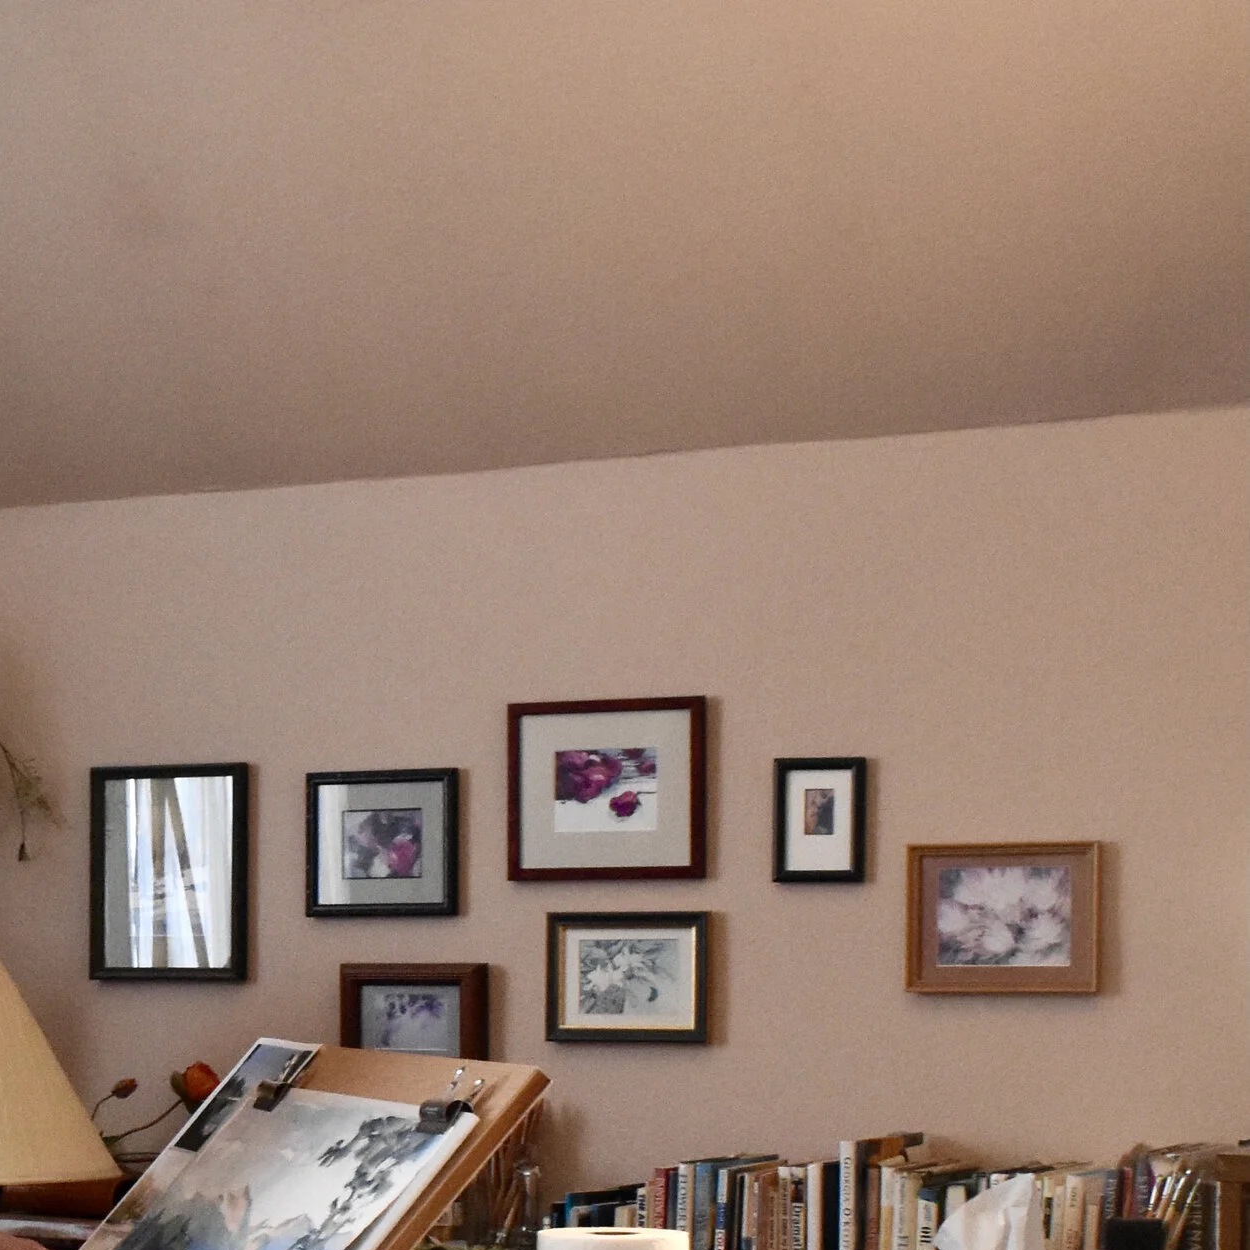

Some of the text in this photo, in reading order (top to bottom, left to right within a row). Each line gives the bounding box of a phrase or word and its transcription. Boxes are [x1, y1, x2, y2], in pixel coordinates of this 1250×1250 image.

[638, 1193, 647, 1211] THE
[677, 1174, 688, 1221] FLOWER
[921, 1226, 932, 1244] OIL
